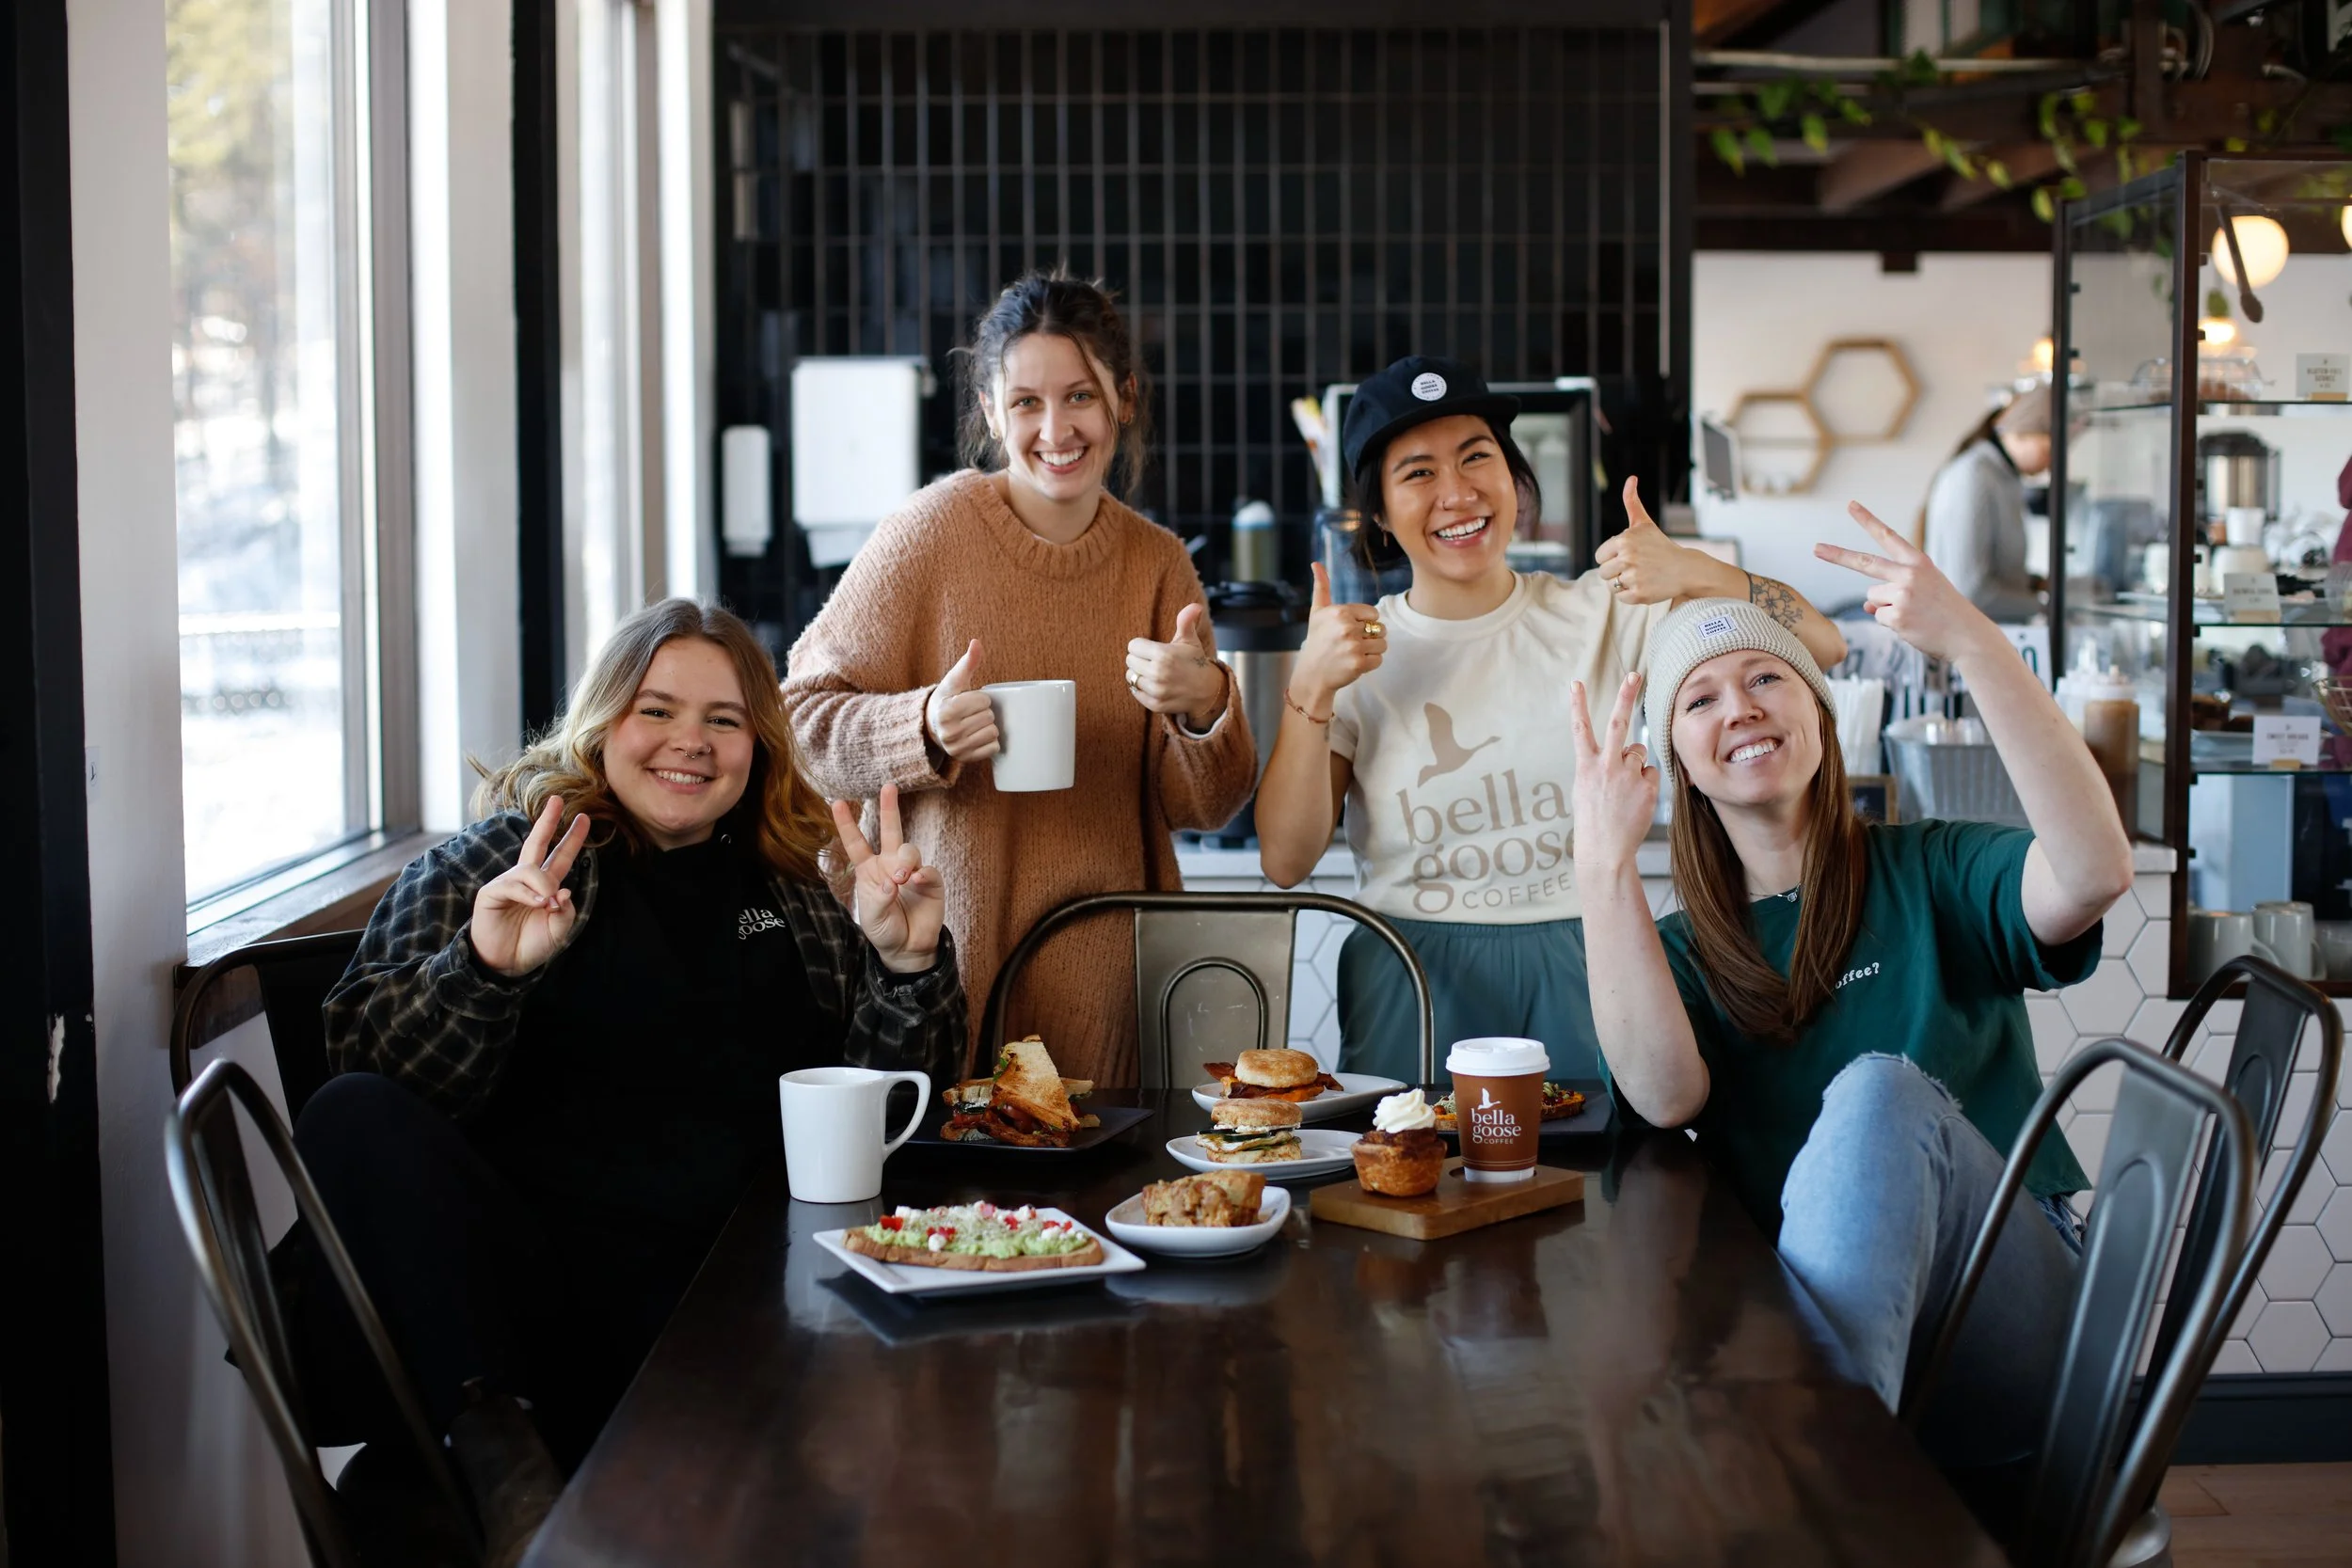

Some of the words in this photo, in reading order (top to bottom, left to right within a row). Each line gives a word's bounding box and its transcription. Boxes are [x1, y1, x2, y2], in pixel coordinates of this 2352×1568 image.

[1395, 768, 1570, 847] bella
[1462, 872, 1571, 910] COFFEE
[739, 908, 774, 924] ella
[1835, 962, 1880, 989] offee?
[1471, 1108, 1515, 1125] bella
[1472, 1123, 1521, 1144] goose
